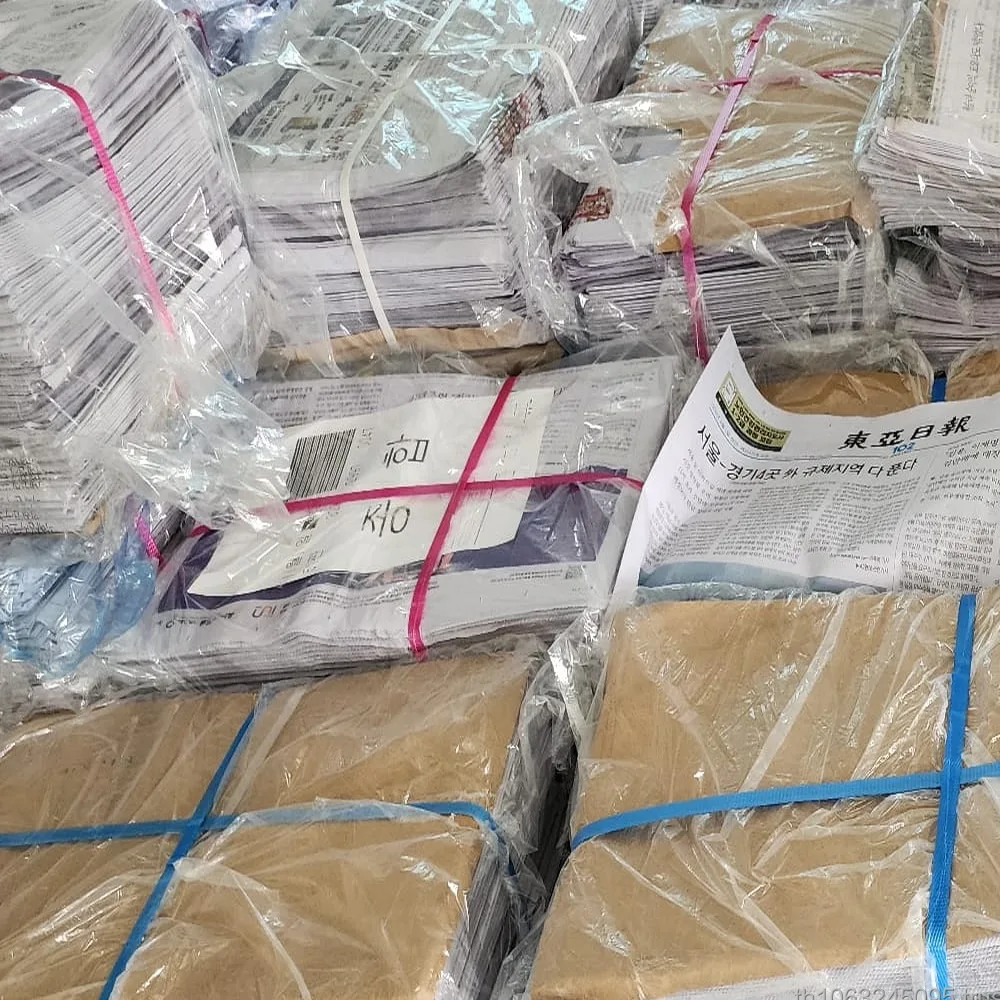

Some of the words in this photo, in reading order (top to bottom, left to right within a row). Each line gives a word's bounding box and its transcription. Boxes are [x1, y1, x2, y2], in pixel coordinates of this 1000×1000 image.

[838, 415, 972, 450] 東亞日報
[803, 463, 866, 477] 규제지역
[868, 465, 883, 478] 다
[886, 459, 918, 477] 푼다
